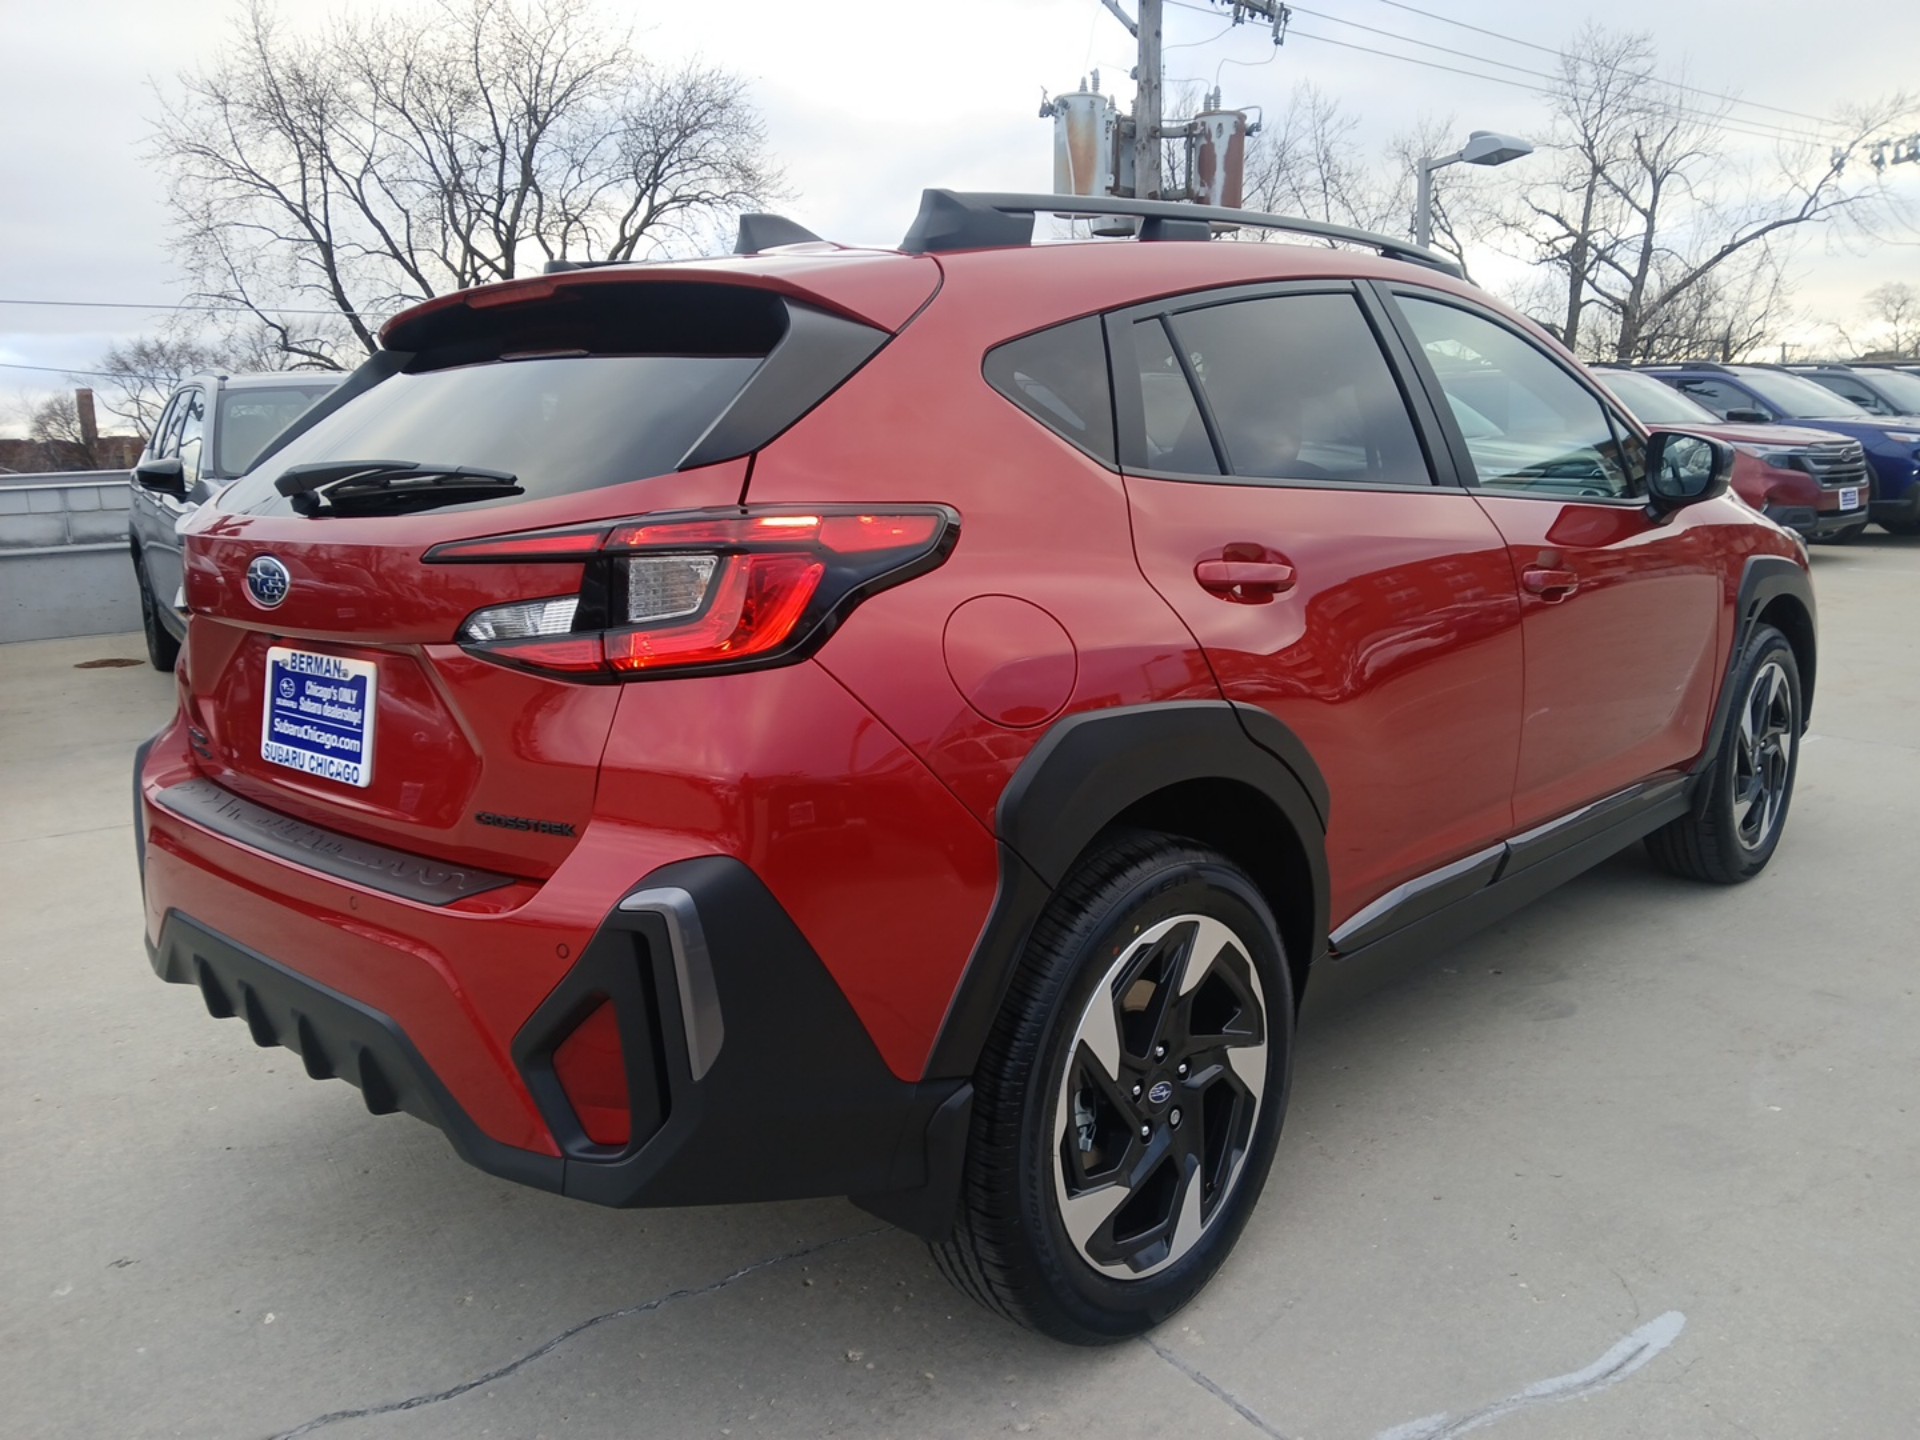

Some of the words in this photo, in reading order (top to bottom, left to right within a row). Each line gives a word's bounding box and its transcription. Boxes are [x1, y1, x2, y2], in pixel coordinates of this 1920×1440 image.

[290, 652, 342, 678] BERMAN
[305, 680, 338, 701] Chicago's
[338, 687, 358, 704] ONLY
[299, 696, 322, 715] Subaru
[322, 702, 362, 726] dealership!
[273, 718, 361, 753] SubaruChicago.com
[263, 742, 306, 769] SUBARU
[308, 755, 360, 784] CHICAGO
[475, 811, 576, 837] CROSSTREK
